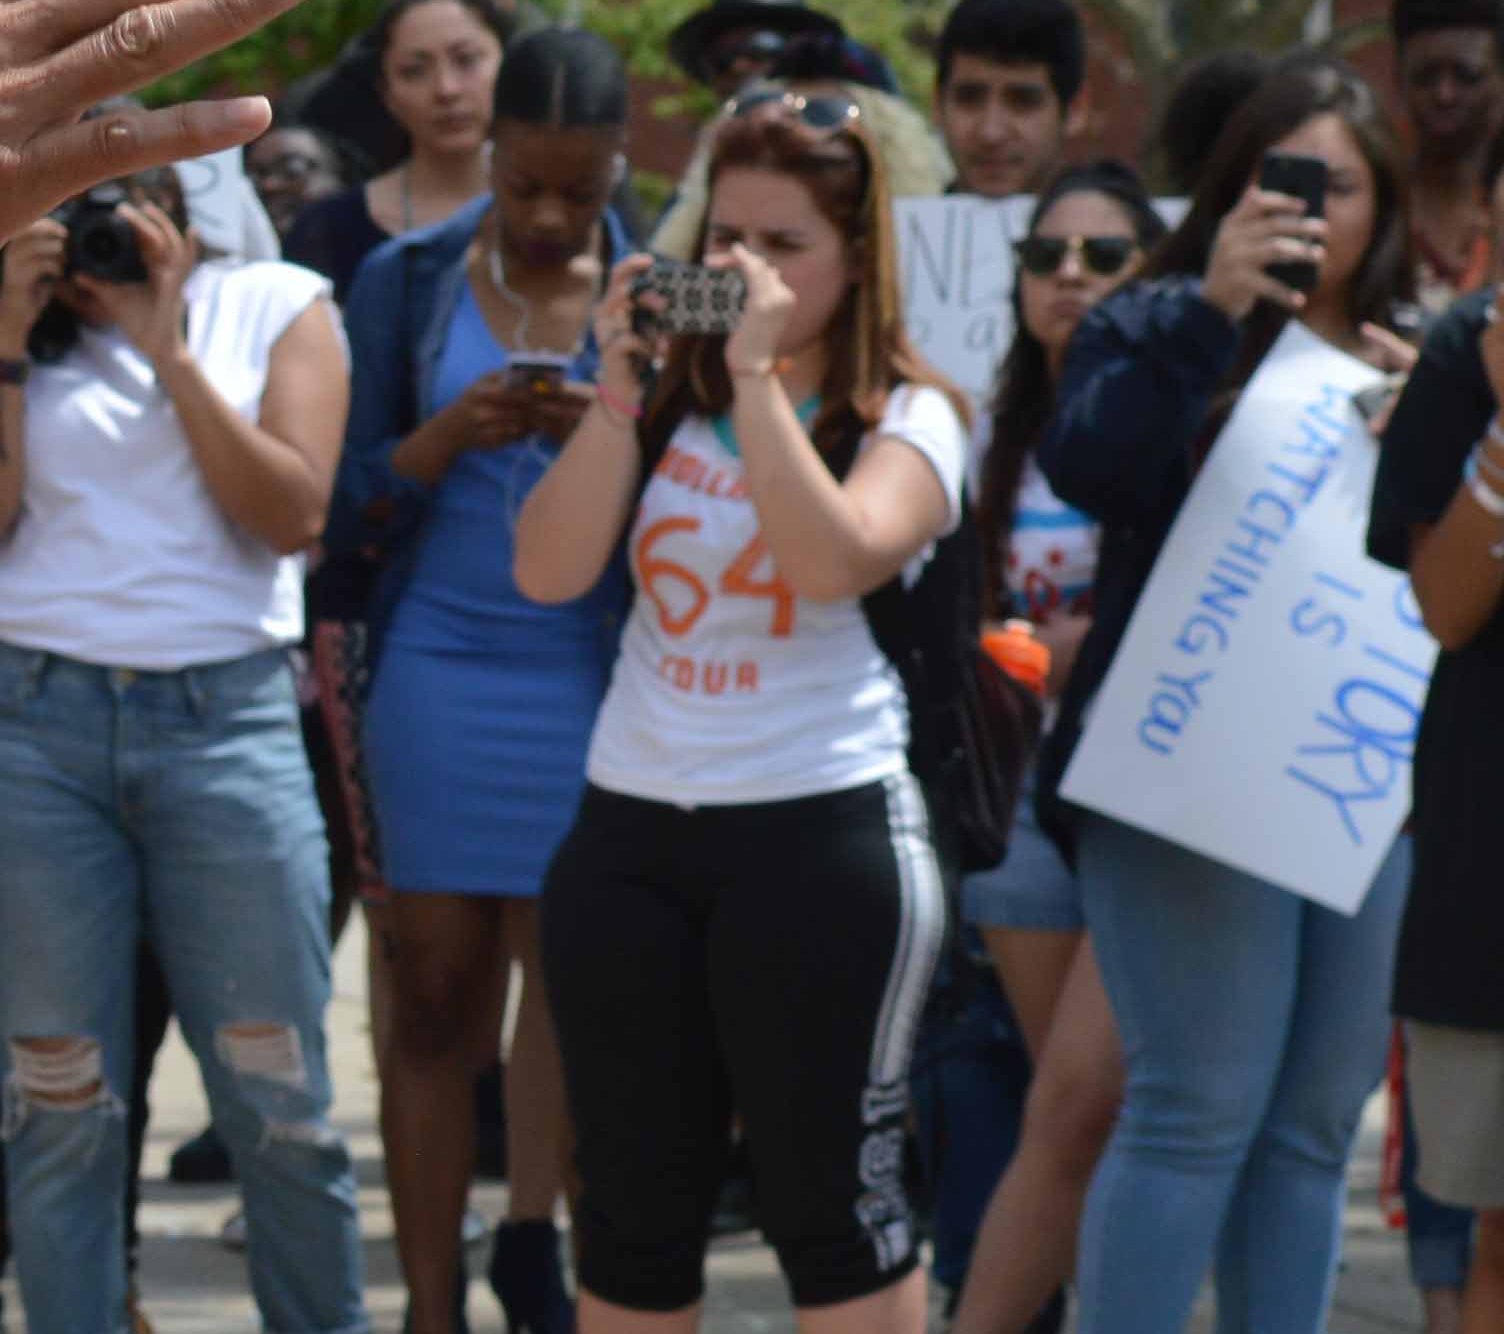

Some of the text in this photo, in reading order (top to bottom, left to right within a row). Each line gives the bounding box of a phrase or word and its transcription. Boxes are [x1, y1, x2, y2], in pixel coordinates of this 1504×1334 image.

[636, 515, 796, 640] 64
[1172, 382, 1354, 654] WATCHING
[1291, 571, 1365, 649] IS
